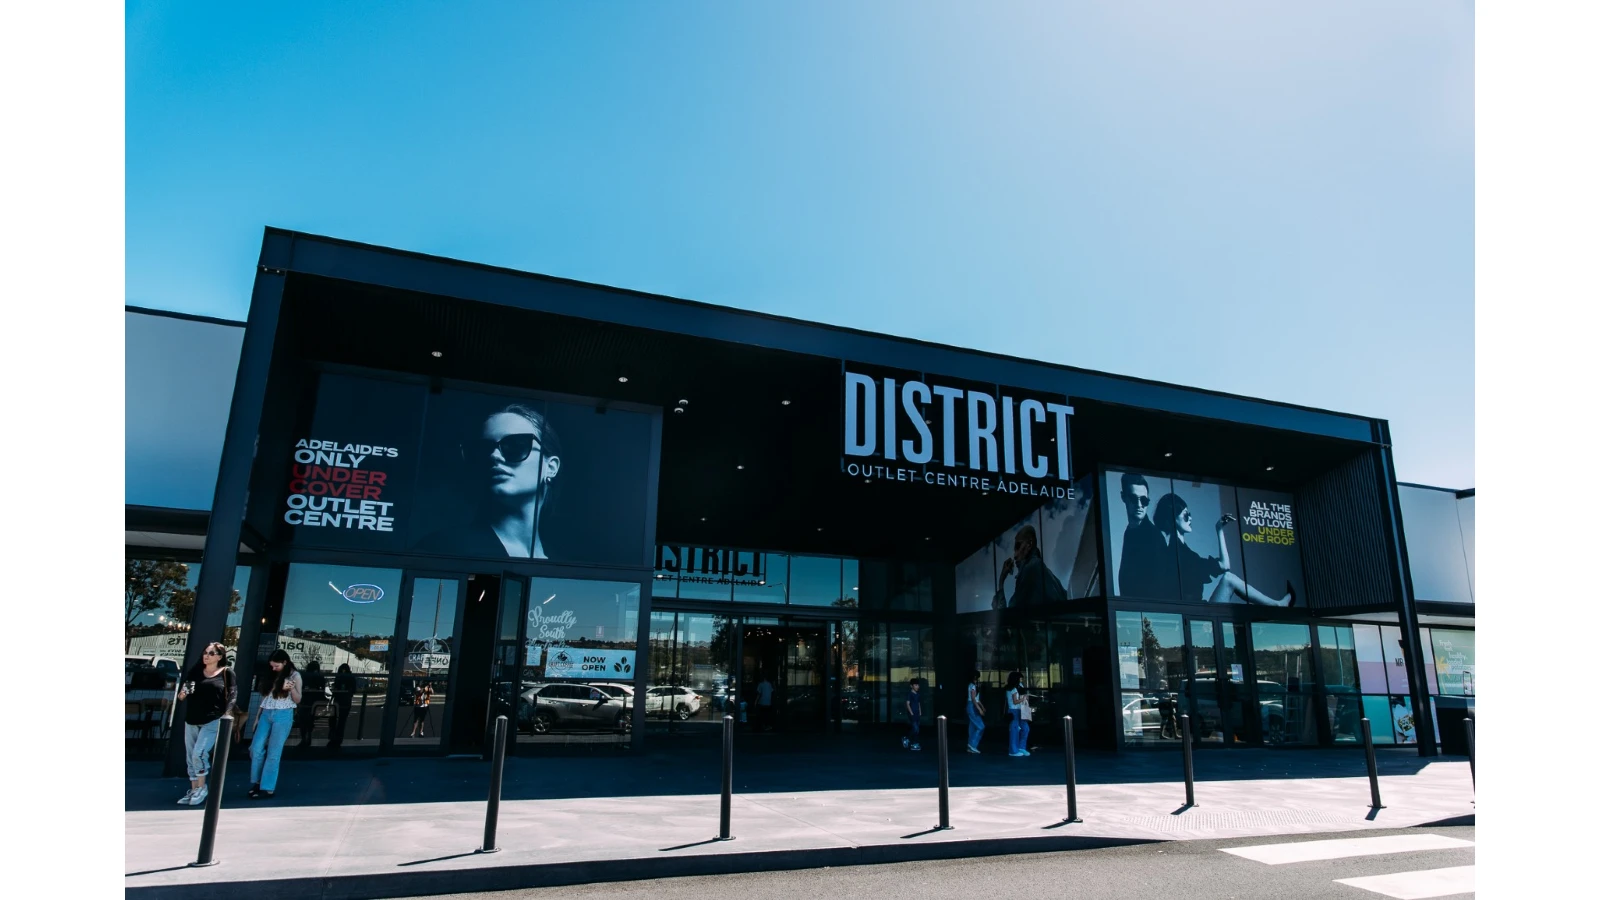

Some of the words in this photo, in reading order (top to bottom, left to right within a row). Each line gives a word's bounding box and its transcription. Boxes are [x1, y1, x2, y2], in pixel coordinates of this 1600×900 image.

[845, 371, 1075, 481] DISTRICT
[295, 439, 399, 457] ADELAIDE'S
[294, 449, 366, 468] ONLY
[292, 464, 387, 486] UNDER
[847, 463, 917, 482] OUTLET
[925, 471, 990, 490] CENTRE
[997, 480, 1075, 499] ADELAIDE
[289, 479, 382, 500] COVER
[286, 493, 394, 516] OUTLET
[1250, 500, 1270, 511] ALL
[1270, 503, 1291, 513] THE
[284, 509, 394, 532] CENTRE
[1243, 516, 1265, 526] YOU
[1266, 519, 1293, 530] LOVE
[1249, 509, 1292, 521] BRANDS
[1242, 532, 1265, 543] ONE
[1266, 535, 1295, 546] ROOF
[1257, 526, 1294, 538] UNDER
[655, 545, 761, 577] ISTRICT
[345, 588, 380, 600] OPEN
[528, 606, 577, 629] Proudly
[539, 624, 565, 639] South
[582, 664, 606, 672] OPEN
[583, 656, 606, 664] NOW
